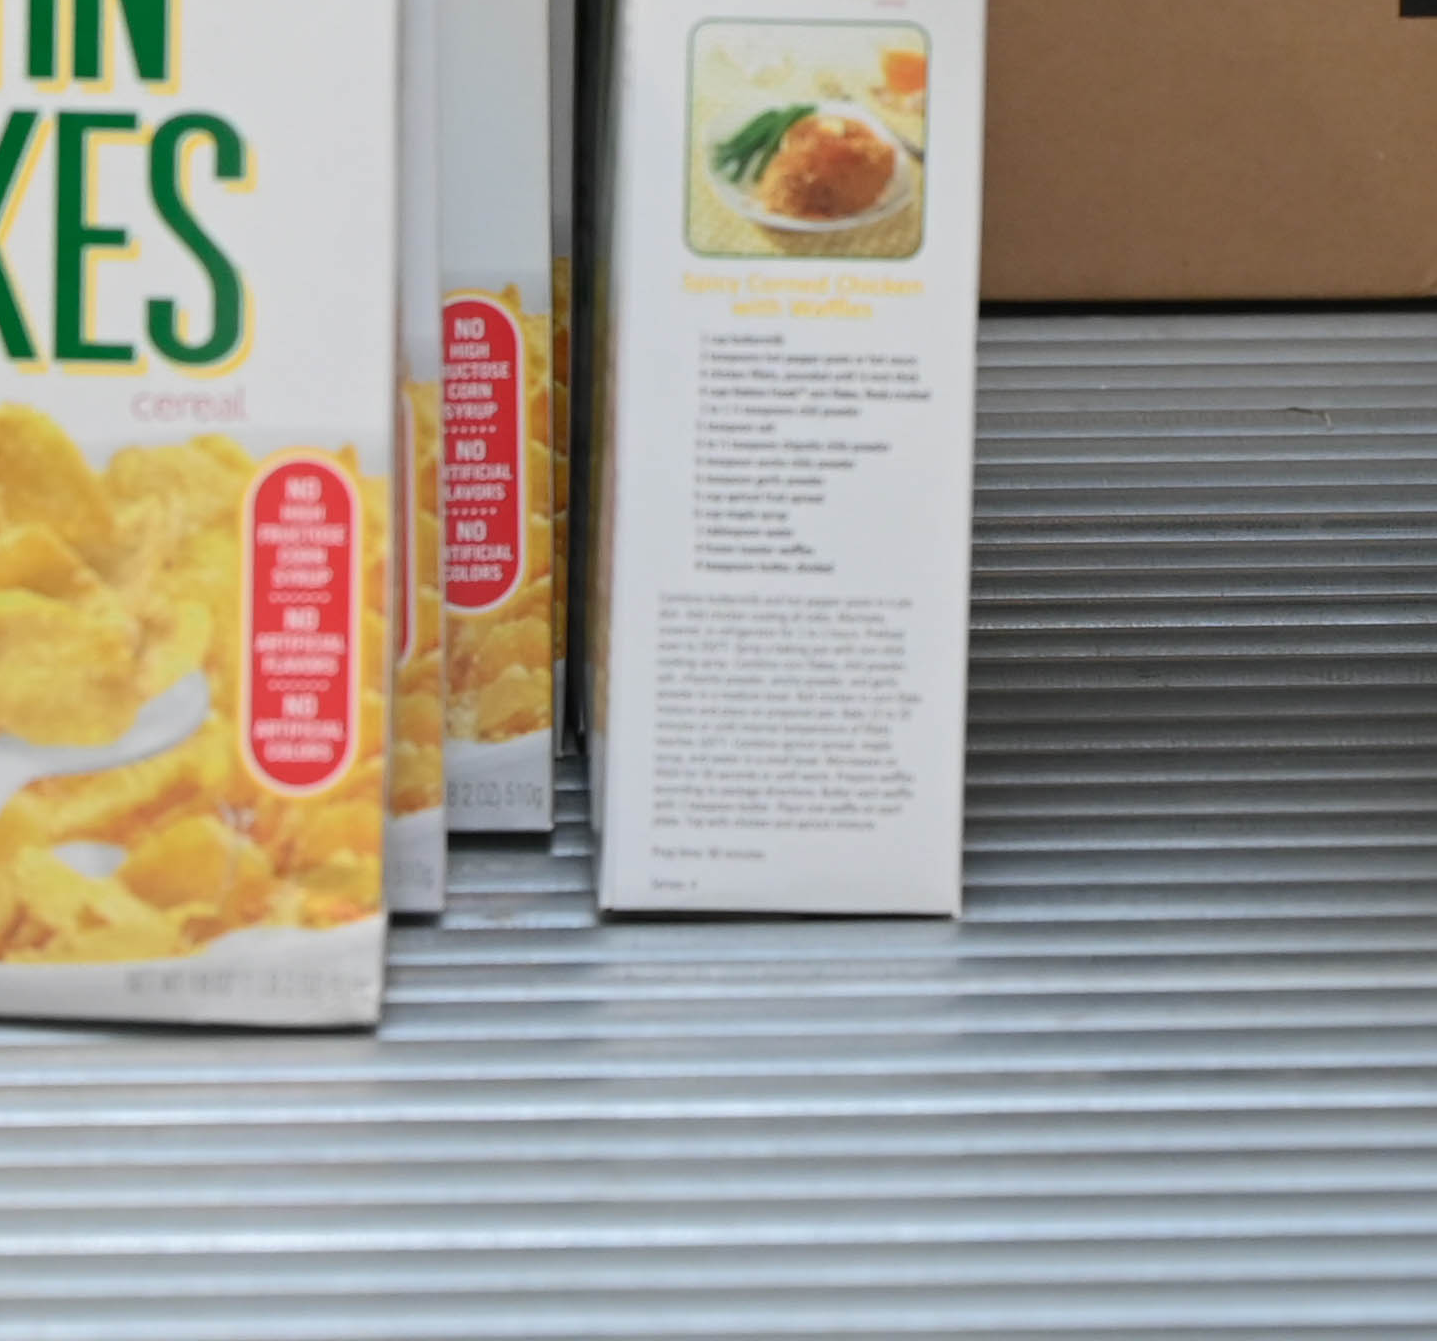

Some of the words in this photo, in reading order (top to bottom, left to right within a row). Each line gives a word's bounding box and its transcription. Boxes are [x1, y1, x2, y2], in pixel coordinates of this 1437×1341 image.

[454, 317, 485, 340] NO
[130, 386, 250, 422] cereal
[456, 438, 487, 461] NO
[456, 519, 487, 542] NO
